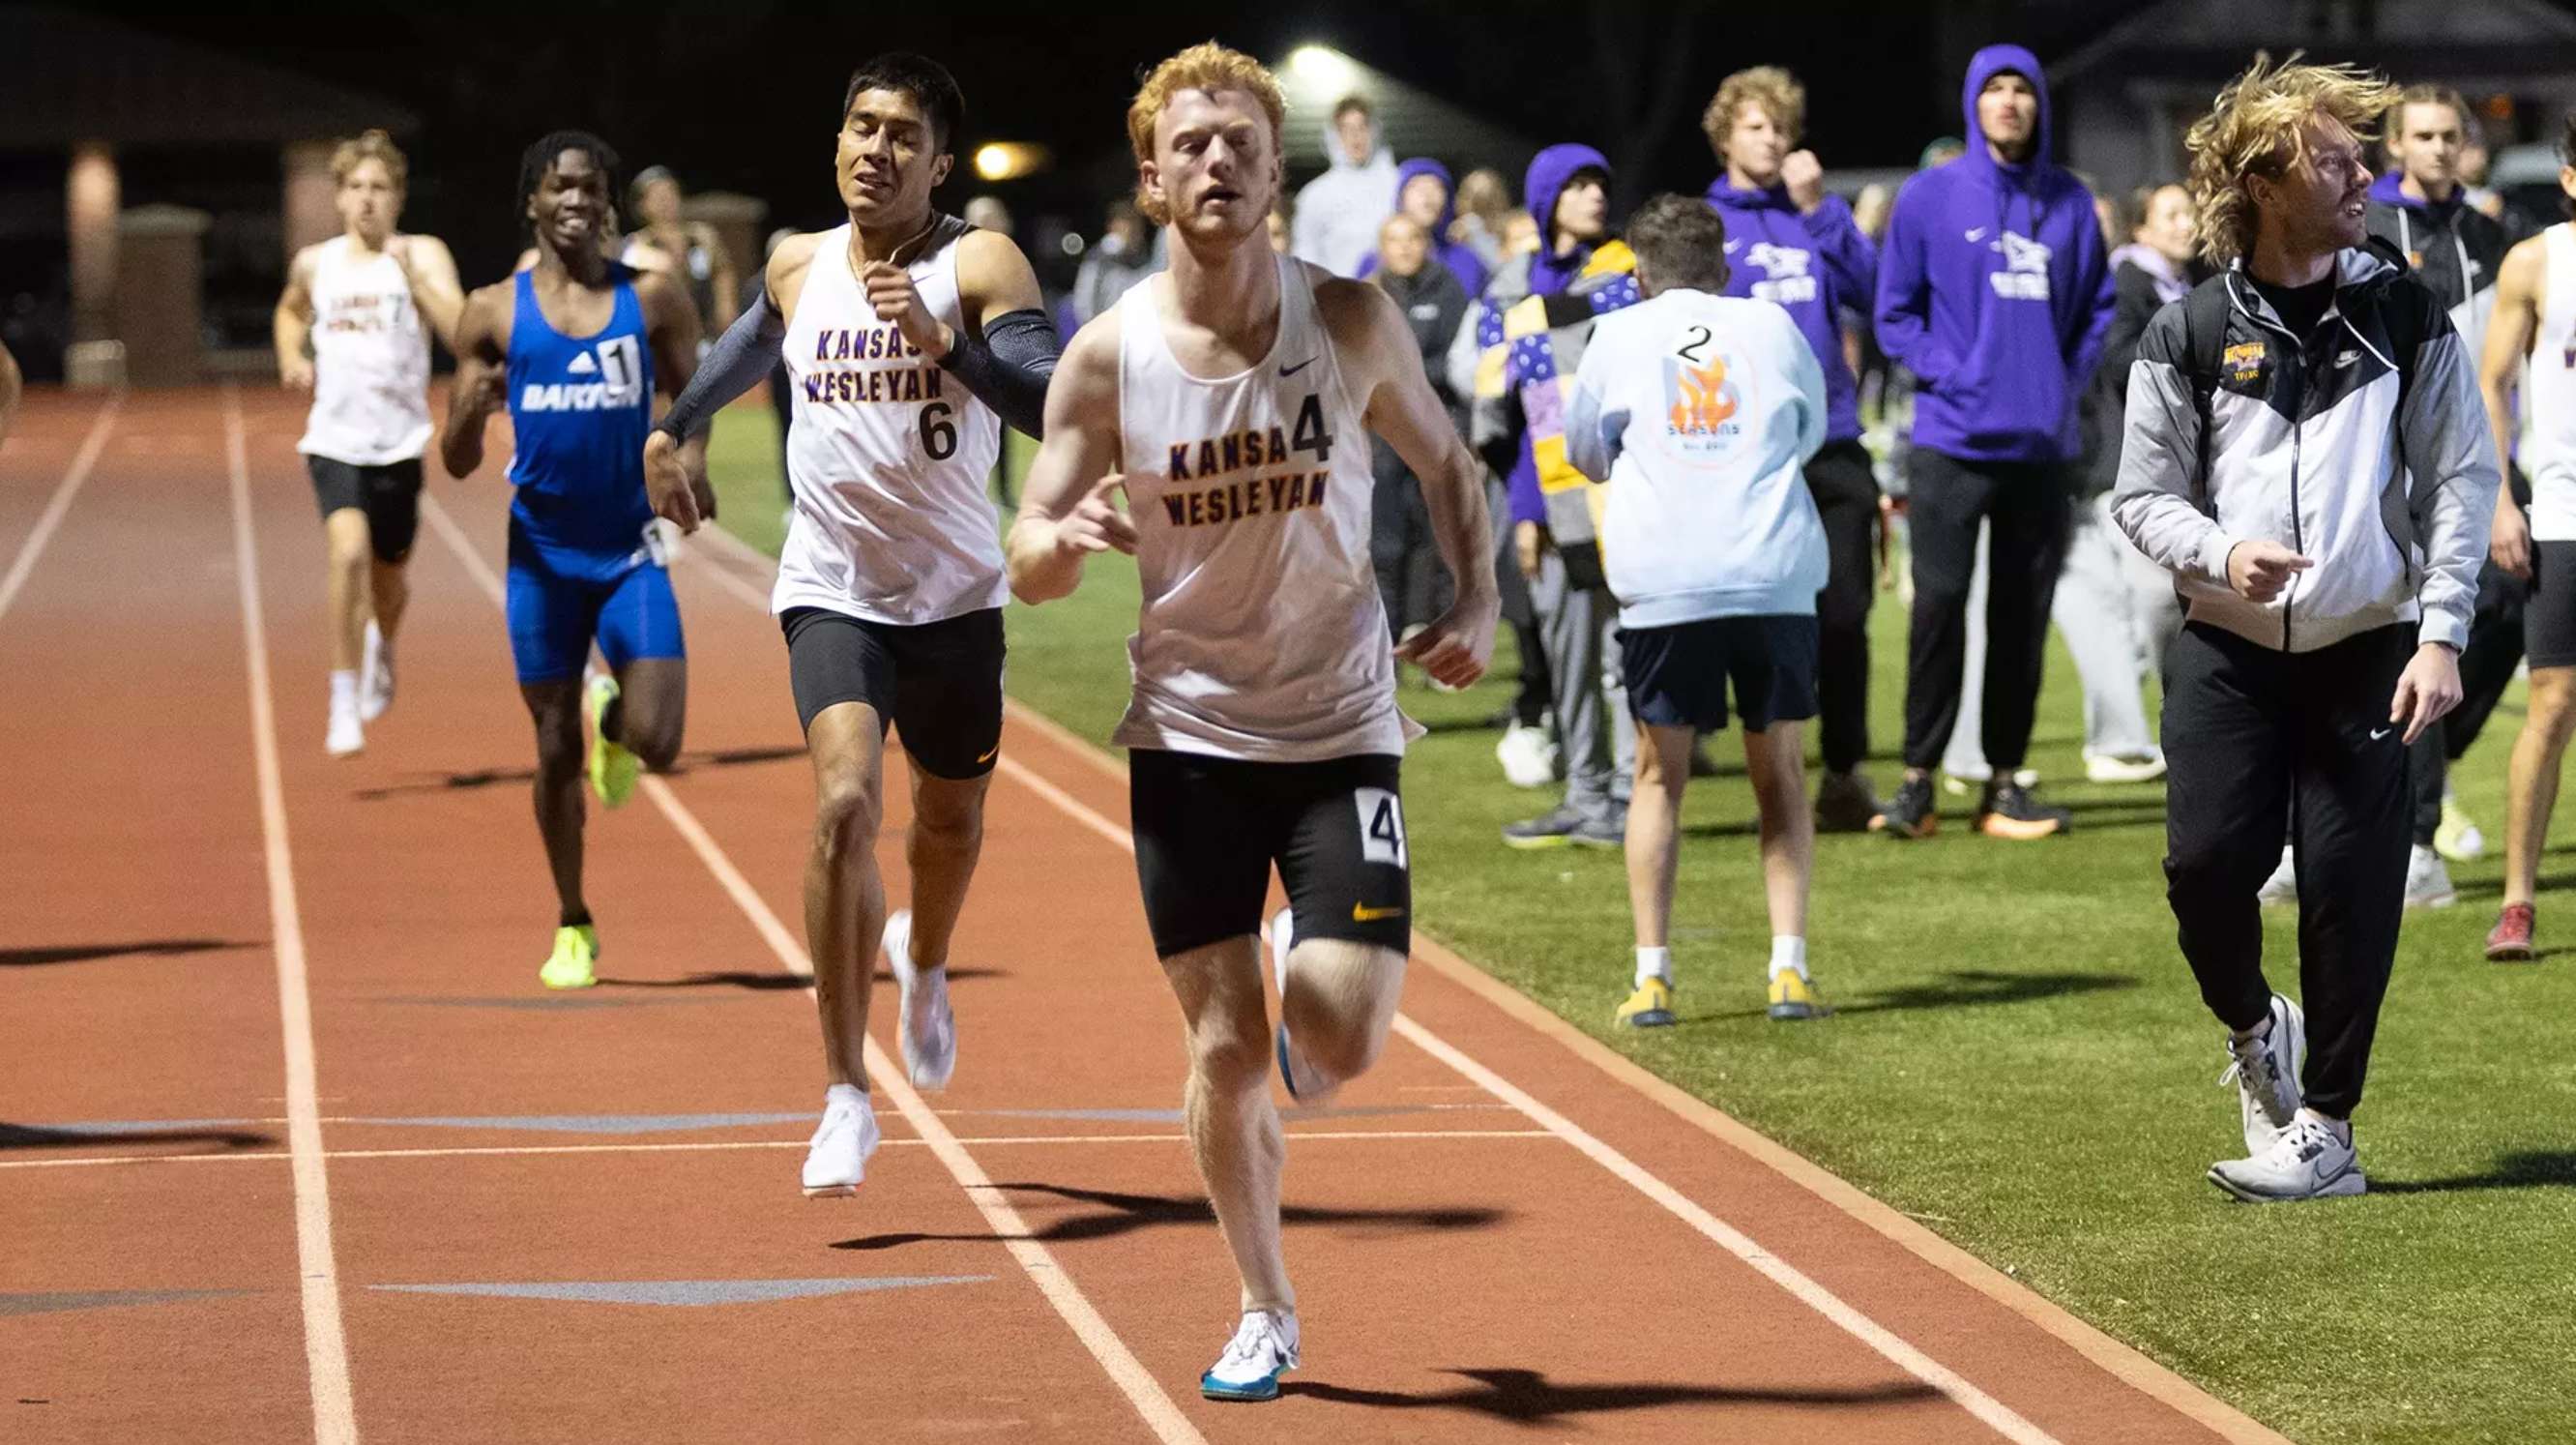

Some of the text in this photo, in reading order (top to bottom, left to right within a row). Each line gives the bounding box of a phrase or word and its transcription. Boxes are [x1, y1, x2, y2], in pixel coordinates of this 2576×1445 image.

[608, 342, 631, 386] 1
[1676, 324, 1712, 363] 2
[805, 368, 942, 402] WESLEYAN
[919, 401, 958, 461] 6
[1291, 393, 1333, 463] 4
[1160, 470, 1331, 527] WESLEYAN
[1369, 795, 1401, 856] 4
